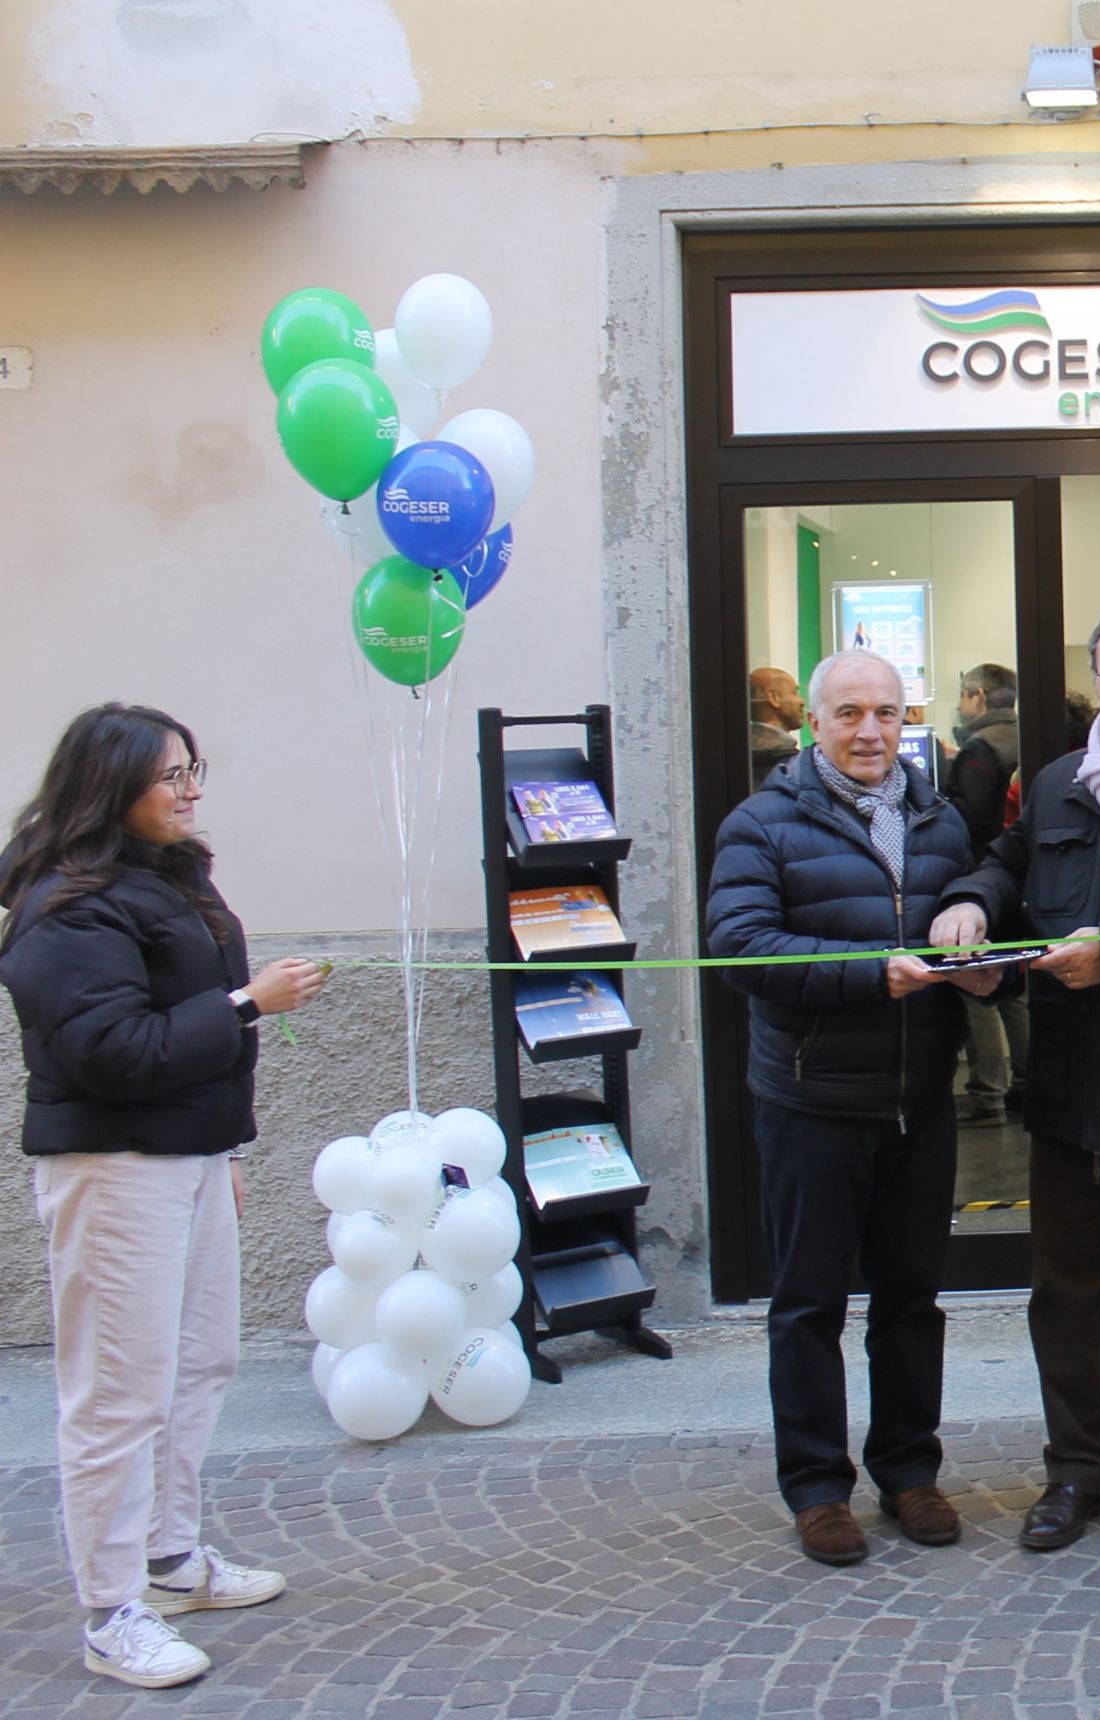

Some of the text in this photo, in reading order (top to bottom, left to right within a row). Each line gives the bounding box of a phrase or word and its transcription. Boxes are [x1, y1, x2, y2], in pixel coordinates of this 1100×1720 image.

[383, 500, 450, 514] COGESER
[409, 515, 450, 524] energia
[364, 635, 428, 647] COGESER
[443, 1337, 485, 1394] COGESER
